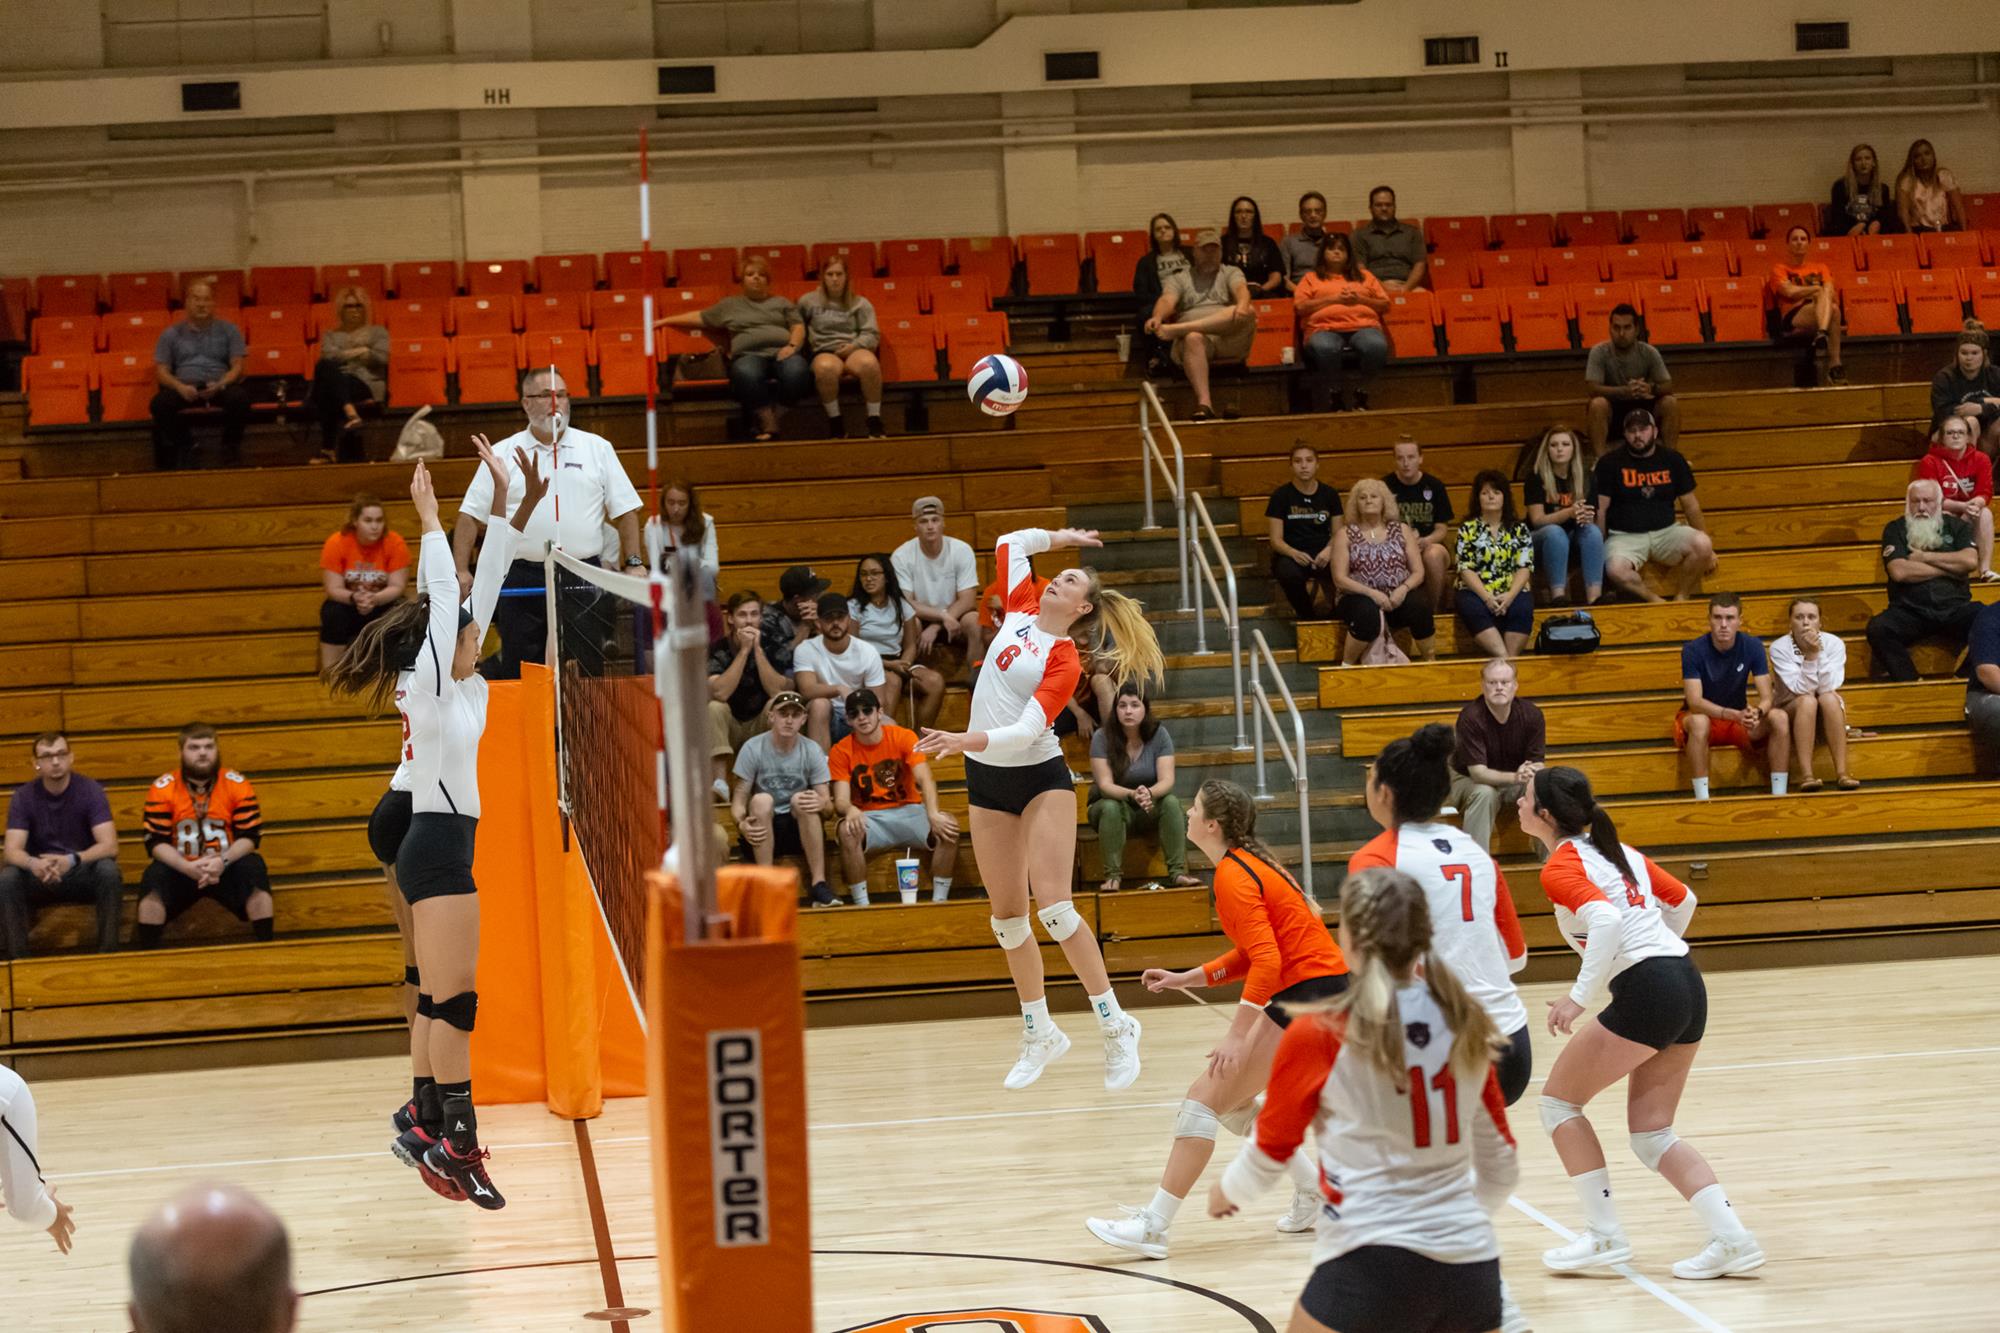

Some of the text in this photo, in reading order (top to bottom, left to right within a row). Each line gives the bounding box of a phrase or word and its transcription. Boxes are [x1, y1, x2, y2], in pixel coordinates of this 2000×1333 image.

[484, 88, 511, 105] HH
[1621, 467, 1672, 488] UPIKE
[995, 644, 1022, 672] 6
[176, 818, 230, 859] 85
[1439, 863, 1475, 922] 7
[1622, 872, 1647, 909] 4
[1396, 1061, 1461, 1149] 11
